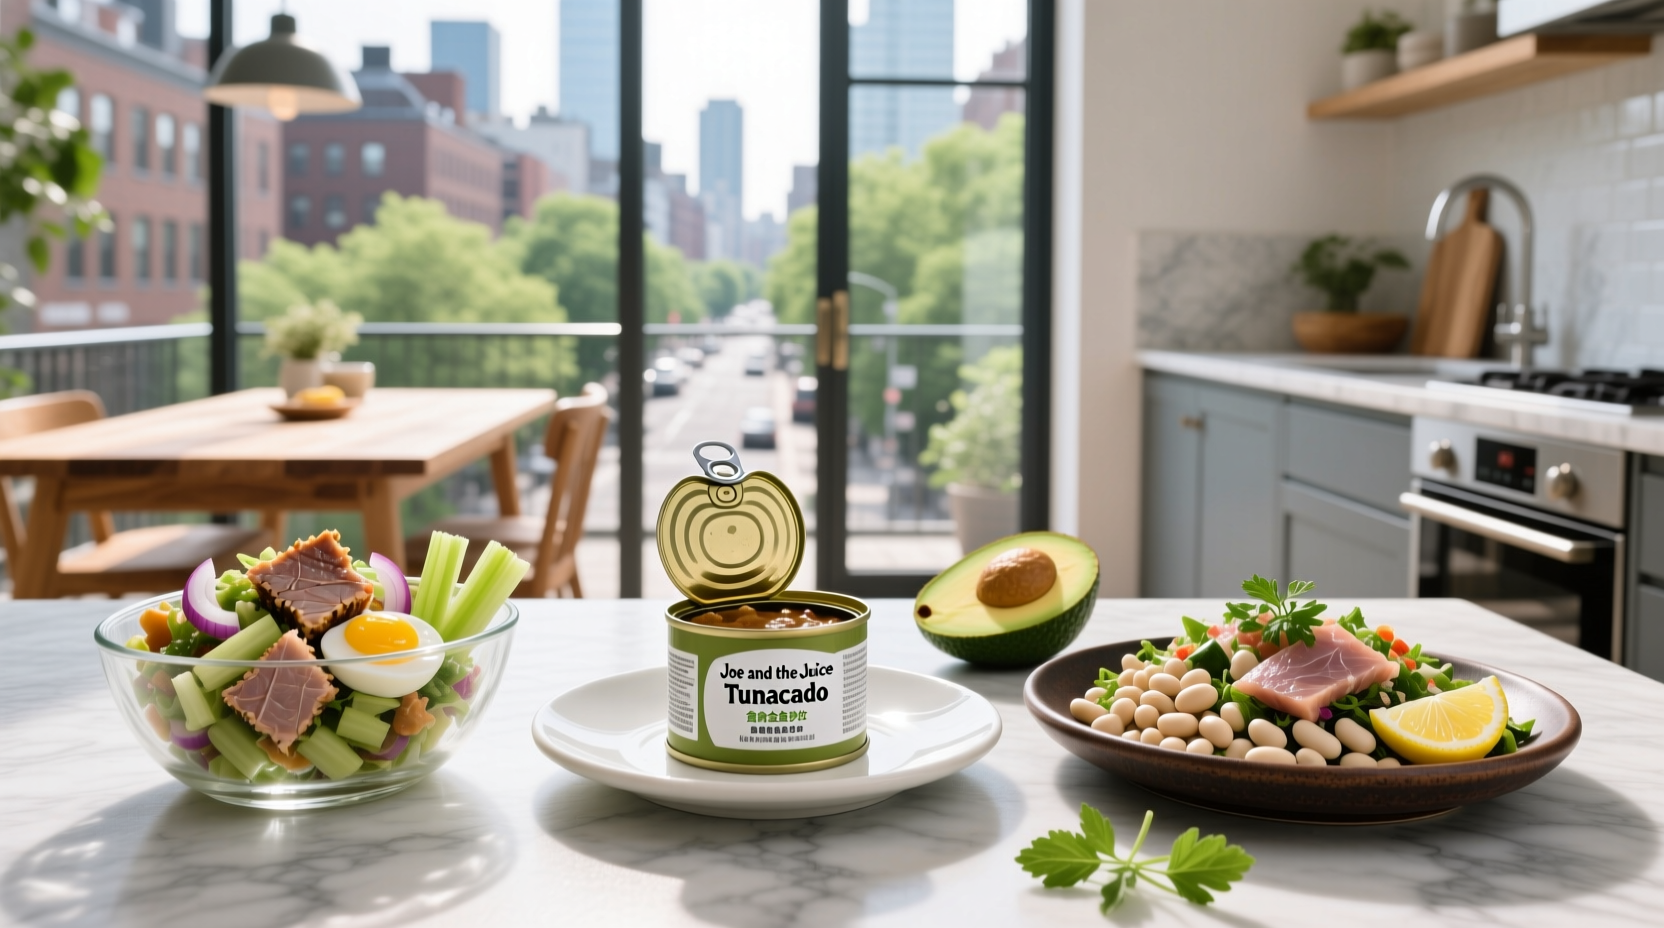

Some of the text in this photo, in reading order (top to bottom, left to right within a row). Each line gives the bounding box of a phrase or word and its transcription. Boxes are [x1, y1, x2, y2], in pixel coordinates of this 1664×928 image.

[720, 662, 834, 680] Joe and the Juice
[724, 682, 829, 705] Tunacado
